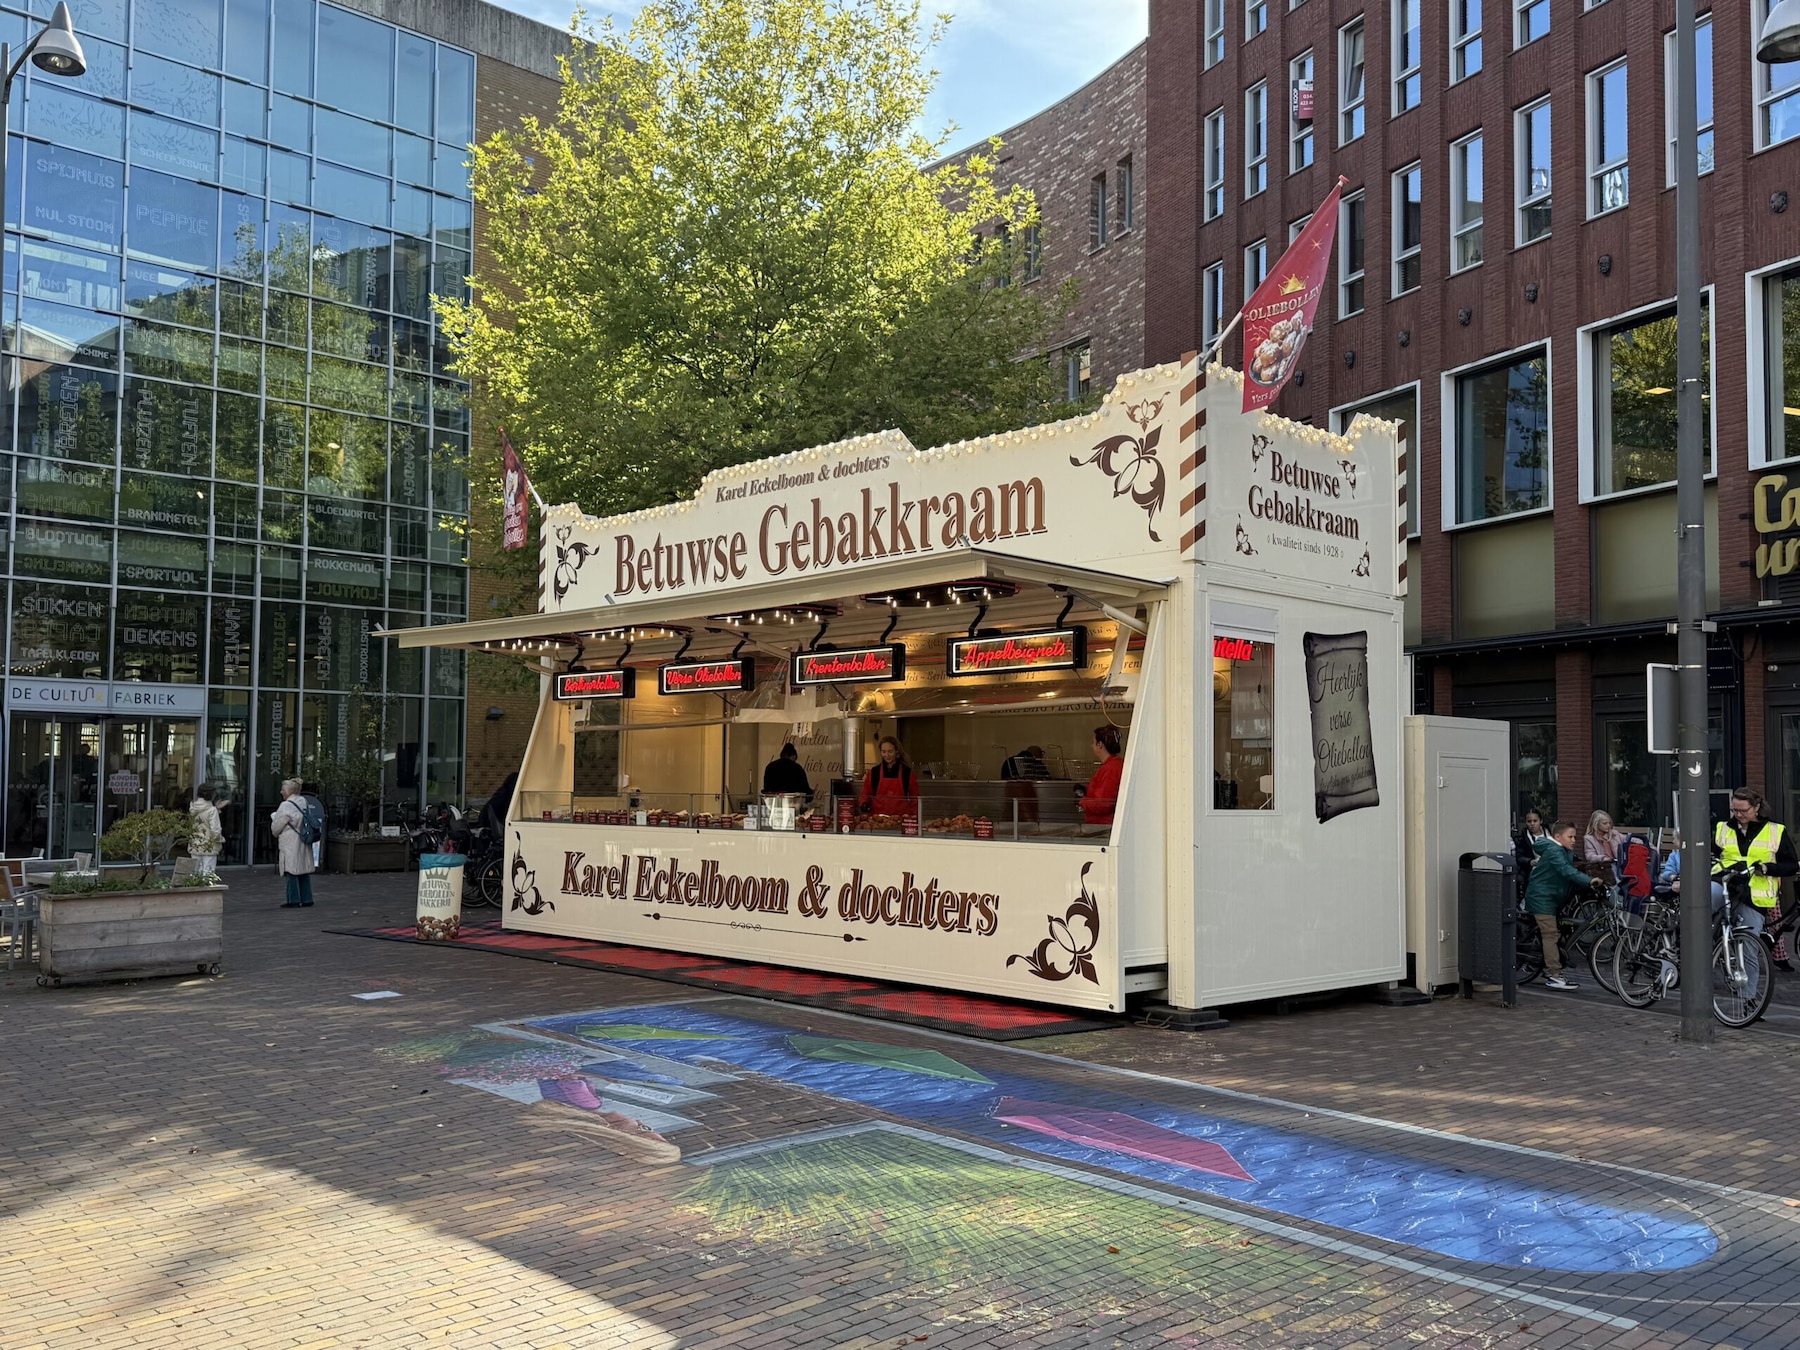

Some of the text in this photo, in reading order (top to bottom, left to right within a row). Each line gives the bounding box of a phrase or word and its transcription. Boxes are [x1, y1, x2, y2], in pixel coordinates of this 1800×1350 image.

[135, 204, 209, 237] PEPPIE
[1249, 283, 1321, 323] OLIEBOLLEN
[59, 375, 80, 450] BREIEN
[182, 399, 199, 466] TUFTEN
[716, 455, 890, 503] Karel Eckelboom & dochters
[1270, 450, 1341, 499] Betuwse
[127, 508, 201, 526] BRANDNETEL
[315, 504, 379, 521] BLOEDWORTEL
[1248, 485, 1360, 541] Gebakkraam
[25, 527, 104, 548] BLOOTWOL
[613, 476, 1049, 597] Betuwse Gebakkraam
[1272, 533, 1339, 558] kwaliteit sinds 1928
[124, 565, 199, 584] SPORTWOL
[314, 557, 379, 574] ROKKENWOL
[22, 596, 101, 617] SOKKEN
[123, 627, 197, 648] DEKENS
[224, 608, 241, 677] WANTEN
[360, 618, 370, 683] BORSTROKKEN
[964, 637, 1066, 668] Appelbeignets
[1213, 636, 1253, 661] utella
[21, 647, 100, 662] TAFELKLEDEN
[805, 652, 887, 676] Krentenbollen
[667, 664, 741, 686] Verse Oliebollen
[1311, 661, 1363, 704] Heerlijk
[13, 688, 31, 699] DE
[115, 692, 176, 706] FABRIEK
[1329, 711, 1352, 731] verse
[270, 700, 283, 775] BIBLIOTHEEK
[1317, 736, 1369, 774] Oliebollen
[561, 851, 999, 936] Karel Eckelboom & dochters
